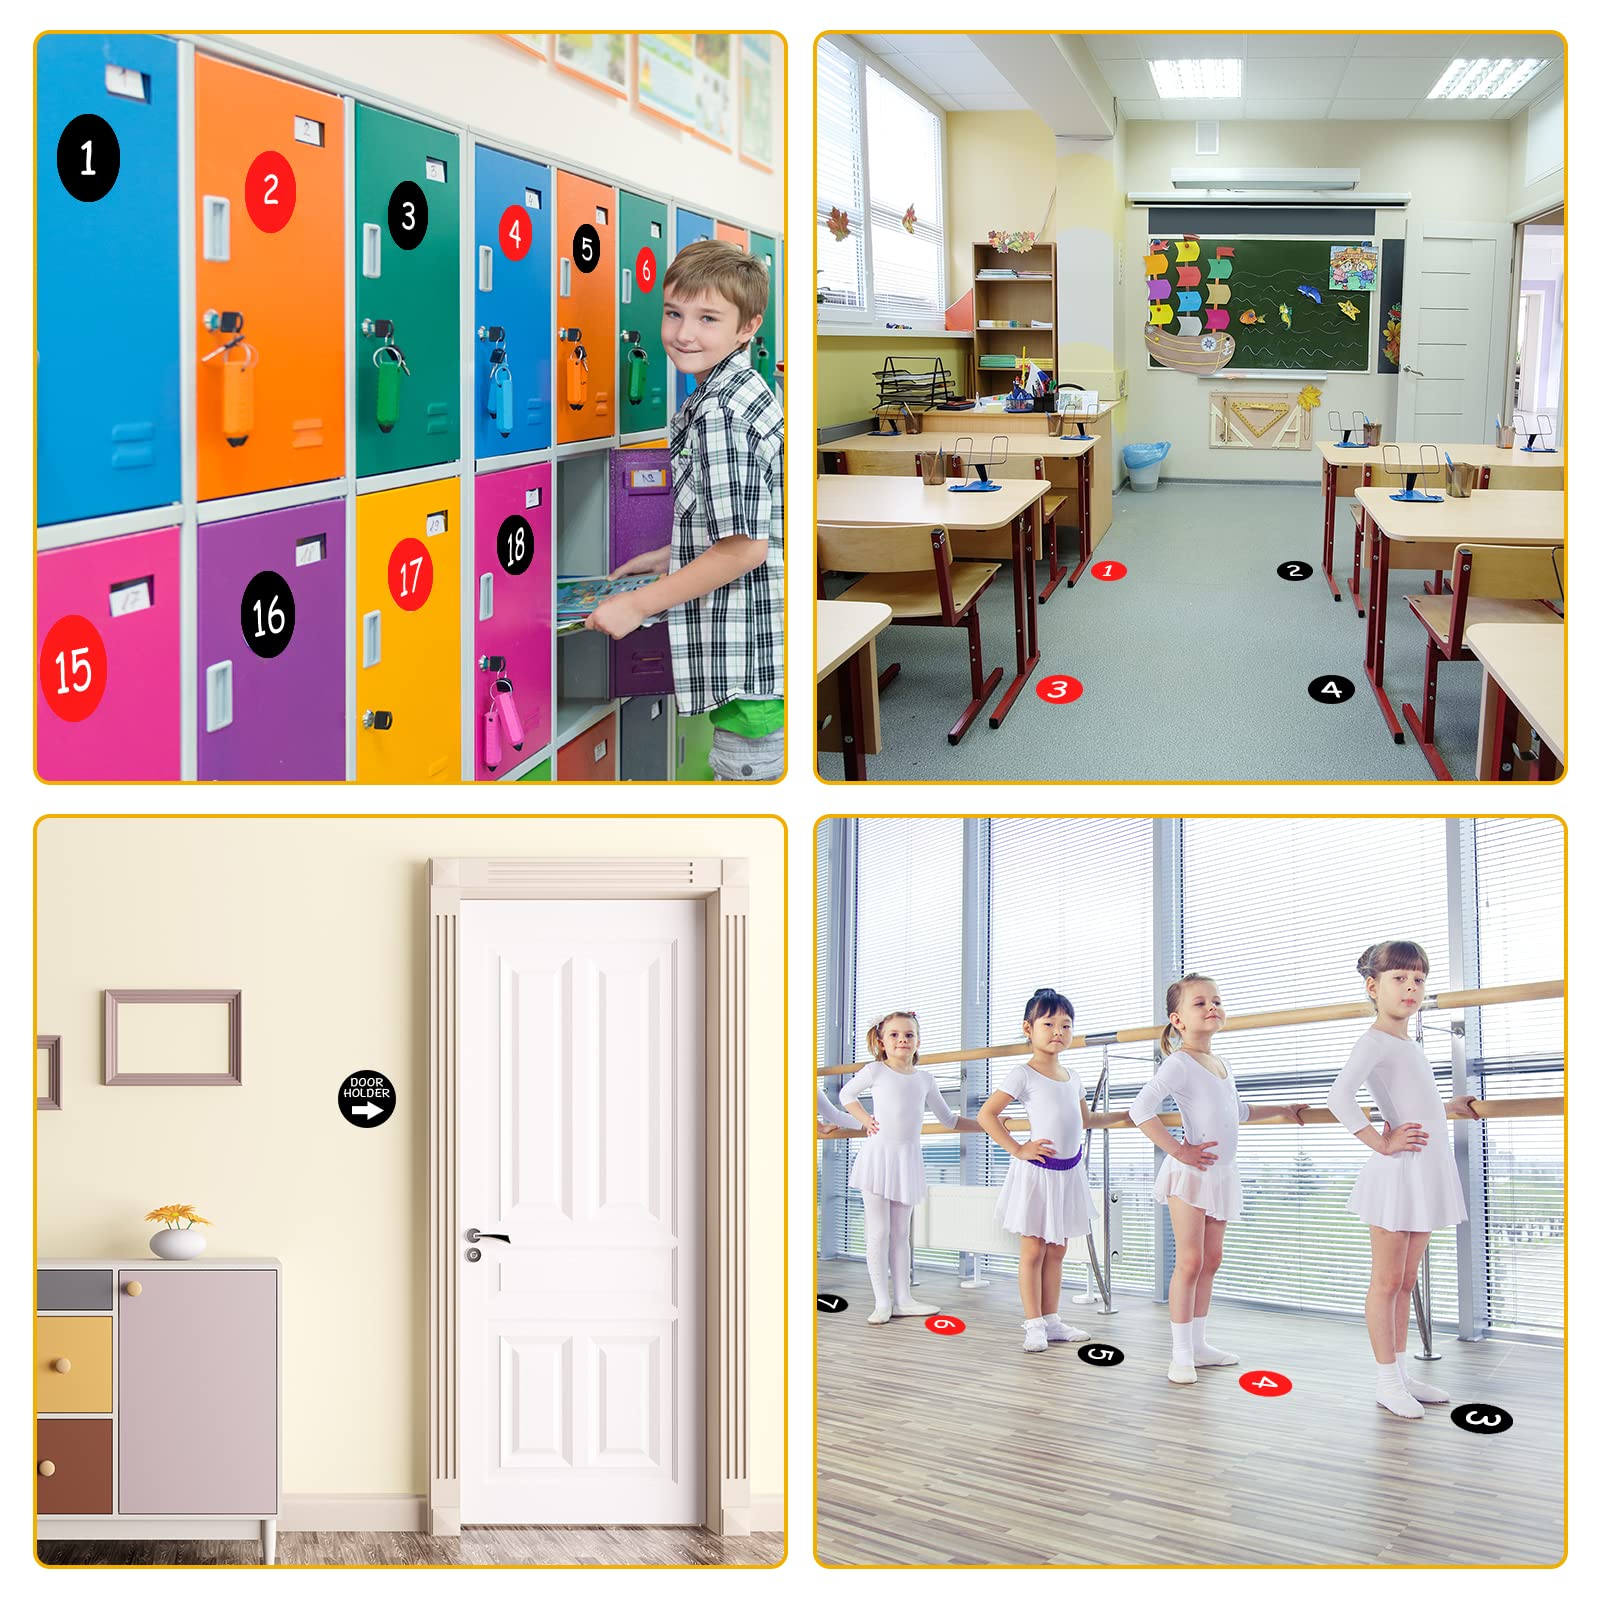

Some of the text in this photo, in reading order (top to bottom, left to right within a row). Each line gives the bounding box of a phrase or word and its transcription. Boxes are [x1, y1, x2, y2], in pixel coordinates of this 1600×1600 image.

[80, 140, 97, 176] 1
[263, 173, 279, 205] 2
[401, 201, 416, 231] 3
[508, 219, 522, 249] 4
[581, 236, 593, 262] 5
[642, 259, 651, 281] 6
[507, 526, 525, 567] 18
[400, 556, 423, 598] 17
[1102, 564, 1113, 577] 1
[1286, 564, 1304, 577] 2
[253, 594, 286, 638] 16
[55, 646, 92, 695] 15
[1046, 680, 1068, 699] 3
[1320, 681, 1343, 699] 4
[343, 1088, 391, 1098] HOLDER
[350, 1077, 384, 1088] DOOR
[1087, 1348, 1115, 1361] 5
[1251, 1375, 1279, 1389] 4
[1465, 1410, 1502, 1427] 3
